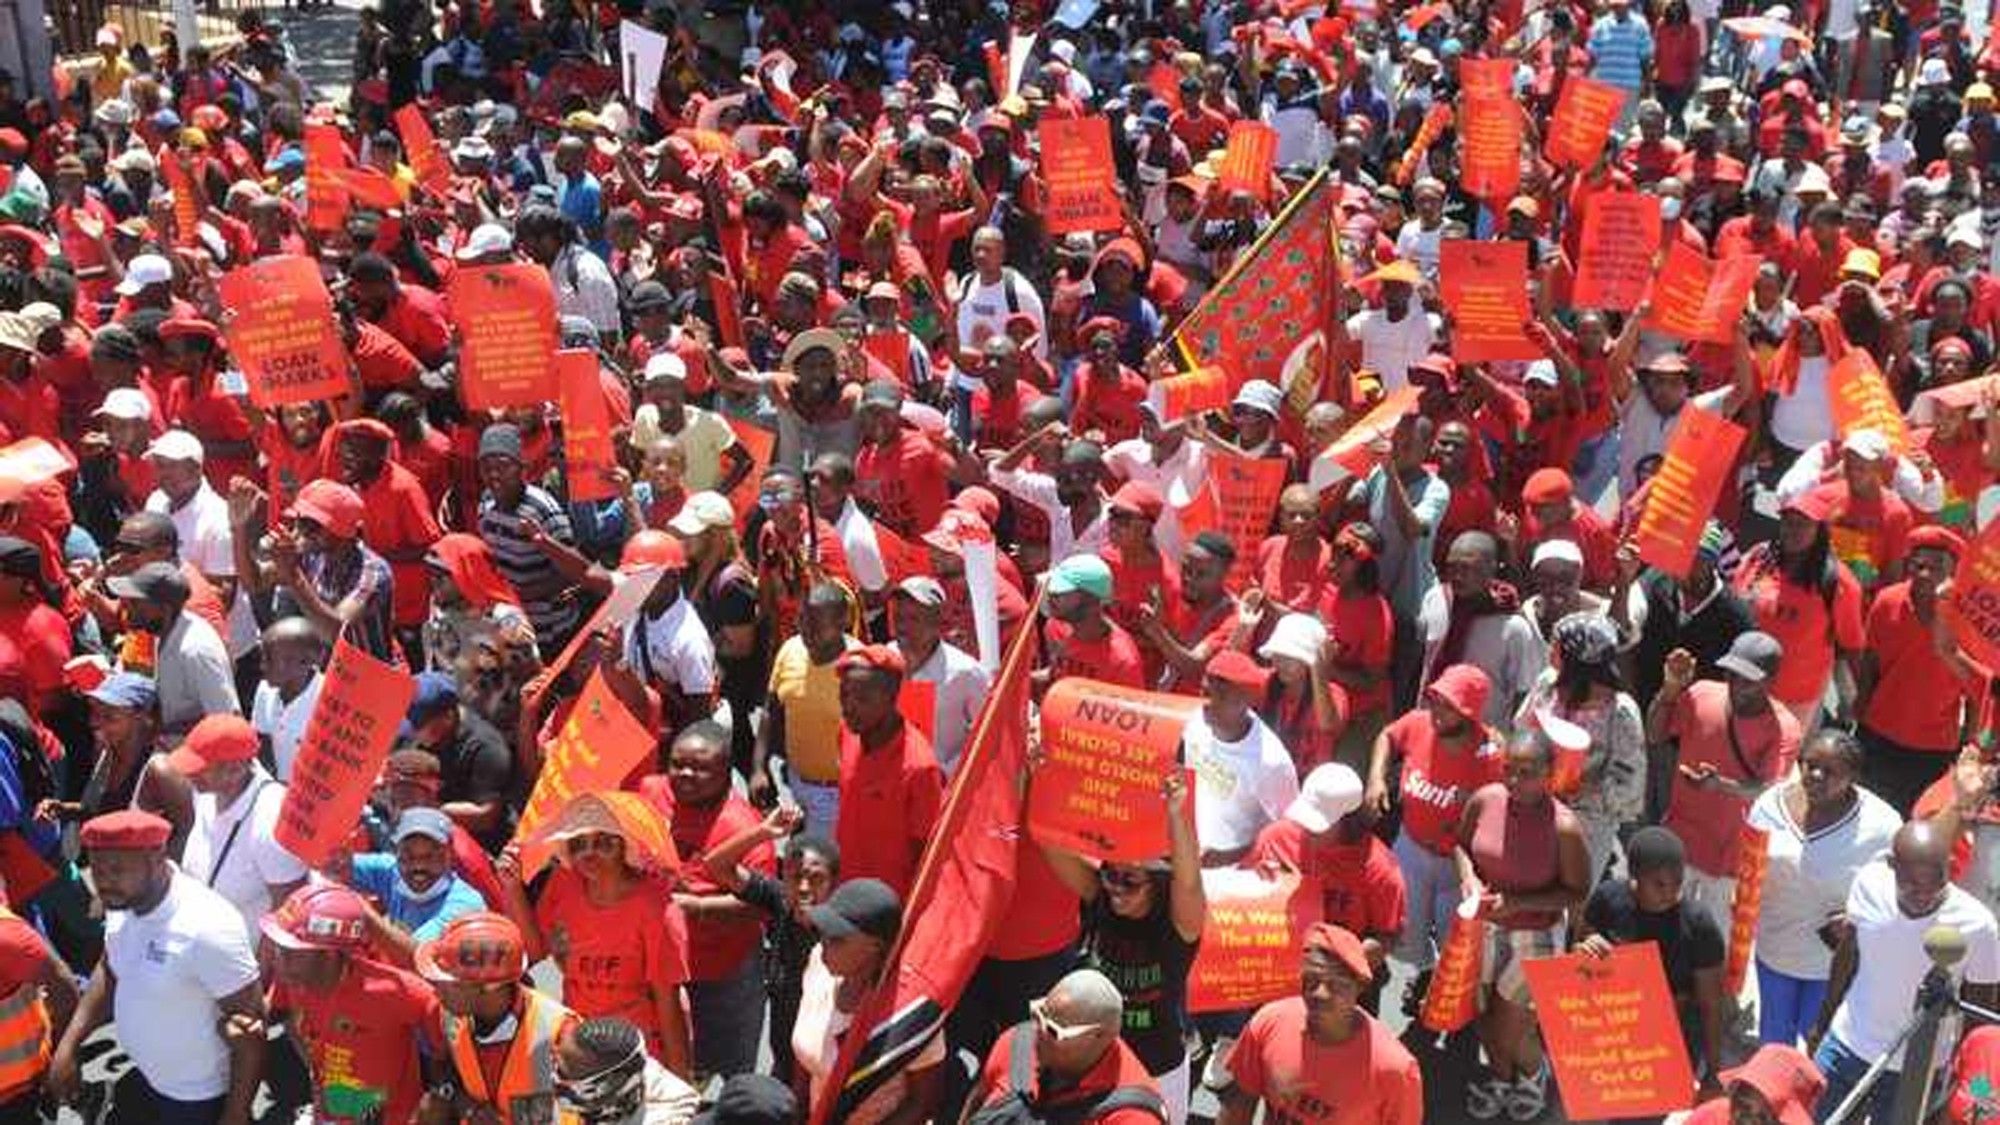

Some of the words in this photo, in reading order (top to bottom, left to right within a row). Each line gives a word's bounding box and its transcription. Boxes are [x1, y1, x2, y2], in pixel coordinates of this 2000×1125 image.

[261, 351, 319, 375] LOAN
[1076, 699, 1152, 734] LOAN
[1100, 761, 1160, 792] WORLD
[1404, 768, 1459, 809] Sunf
[1211, 909, 1242, 926] We
[1247, 908, 1288, 926] Wan
[1221, 928, 1252, 947] The
[459, 937, 512, 967] EFF
[1238, 952, 1272, 969] and
